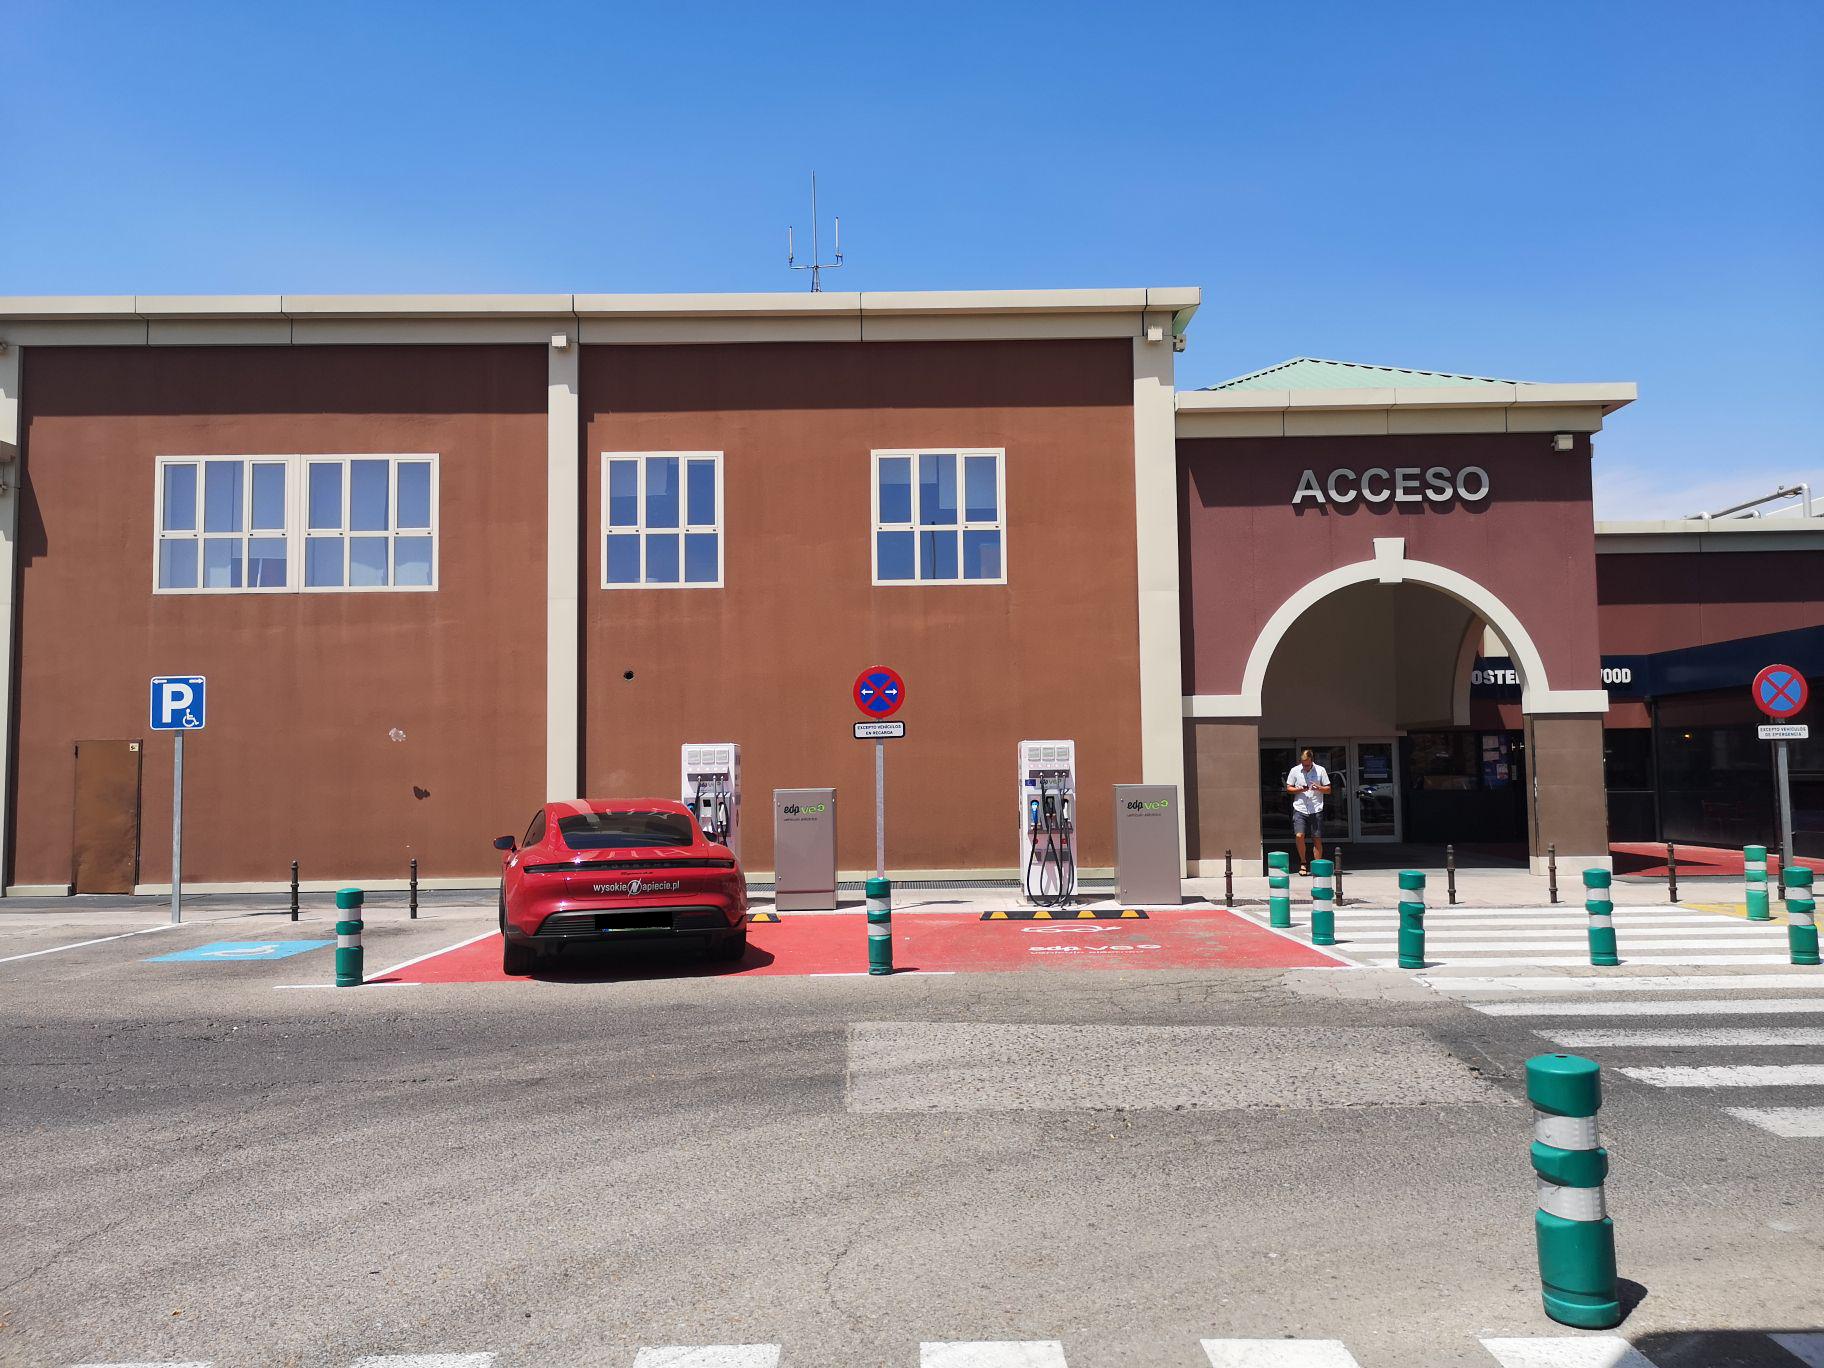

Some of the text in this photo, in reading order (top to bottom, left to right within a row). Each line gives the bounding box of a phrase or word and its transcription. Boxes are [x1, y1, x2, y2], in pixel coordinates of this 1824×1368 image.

[1291, 466, 1490, 504] ACCESO
[1471, 668, 1631, 685] OSTE OOD
[162, 683, 193, 723] P
